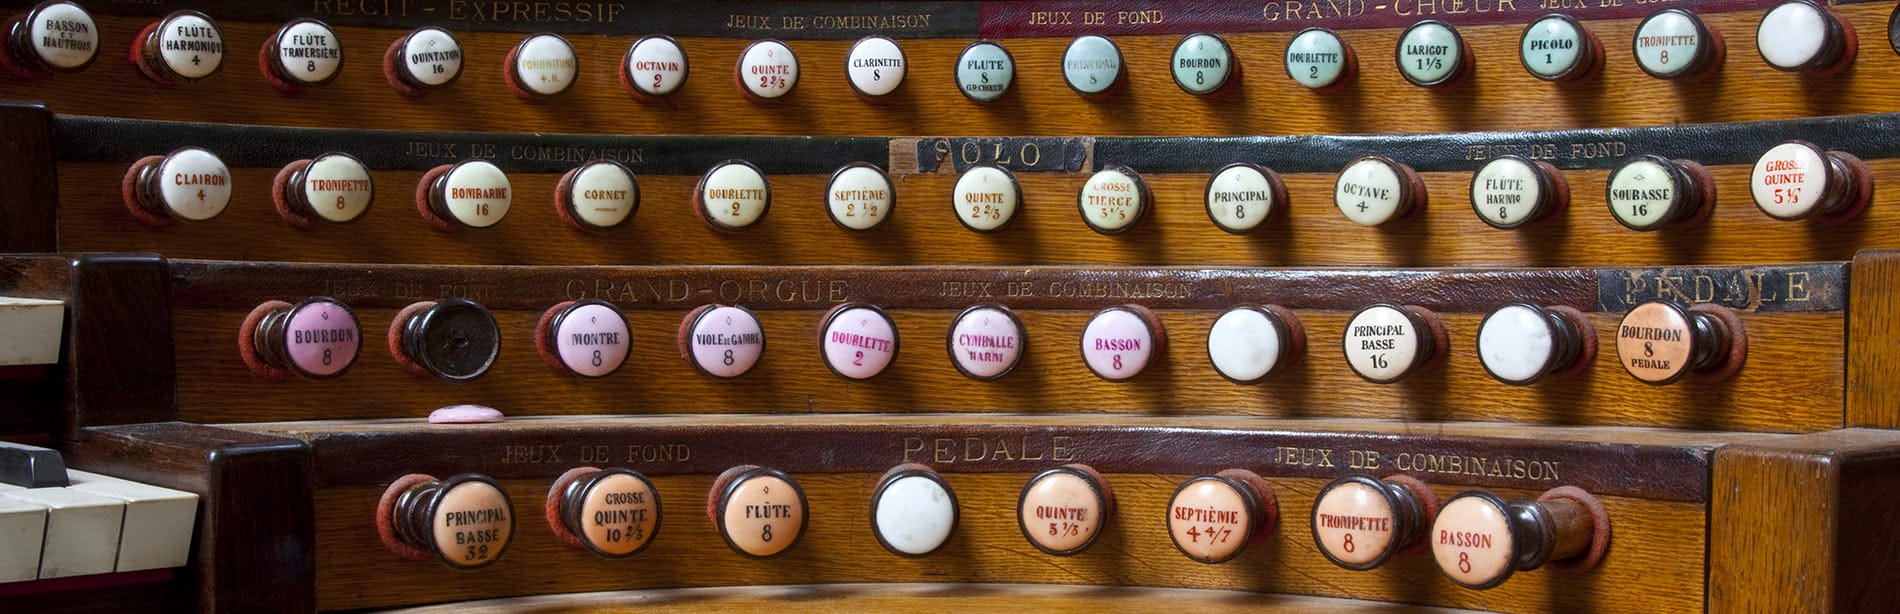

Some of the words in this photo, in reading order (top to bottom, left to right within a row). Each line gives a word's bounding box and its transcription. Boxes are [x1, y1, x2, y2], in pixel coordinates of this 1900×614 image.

[727, 15, 771, 30] JEUX
[783, 16, 804, 29] DE
[813, 14, 930, 29] COMBINAISON
[1029, 12, 1072, 25] JEUX
[1085, 12, 1104, 25] DE
[1118, 11, 1163, 24] FOND
[46, 19, 88, 32] BASSON
[43, 36, 92, 51] HAUTBOIS
[1531, 39, 1573, 50] PICOLO
[1639, 35, 1696, 47] TROMPETTE
[1407, 45, 1448, 56] LARIGOT
[1660, 50, 1669, 64] 8
[192, 54, 200, 65] 4
[411, 51, 460, 64] QUINTATON
[853, 58, 901, 68] CLARINETTE
[1180, 58, 1221, 69] BOURDON
[1290, 53, 1338, 63] DOUBLETTE
[1545, 54, 1552, 64] 1
[307, 60, 316, 72] 8
[432, 64, 444, 74] 16
[636, 61, 678, 72] OCTAVIN
[751, 65, 789, 75] QUINTE
[967, 60, 1004, 70] FLUTE
[1067, 59, 1117, 70] PRINCIPAL
[1417, 59, 1423, 70] 1
[873, 69, 881, 81] 8
[981, 72, 988, 84] 8
[1090, 74, 1097, 84] 8
[1196, 70, 1204, 85] 8
[1310, 66, 1318, 79] 2
[653, 73, 662, 88] 2
[760, 77, 768, 88] 2
[406, 142, 457, 158] JEUX
[471, 144, 496, 159] DE
[511, 145, 643, 163] COMBINAISON
[935, 140, 1040, 166] SOLO
[1530, 144, 1555, 160] DE
[1571, 142, 1626, 159] FOND
[1766, 160, 1806, 172] GROSS
[175, 173, 225, 186] CLAIRON
[311, 179, 369, 192] TROMPETTE
[1764, 173, 1804, 185] QUINTE
[196, 189, 205, 201] 4
[452, 187, 507, 200] BOMBARDE
[584, 190, 627, 200] CORNET
[709, 189, 763, 200] DOUBLETTE
[1214, 190, 1268, 203] PRINCIPAL
[1344, 182, 1389, 200] OCTAVE
[1612, 188, 1670, 201] SOUBASSE
[1774, 189, 1783, 204] 5
[336, 196, 345, 209] 8
[965, 193, 1004, 203] QUINTE
[1088, 195, 1132, 206] TIERCE
[476, 203, 489, 216] 16
[732, 202, 740, 216] 2
[846, 204, 855, 216] 2
[972, 206, 980, 218] 2
[1236, 205, 1245, 219] 8
[1356, 201, 1369, 212] 4
[1499, 206, 1507, 219] 8
[1631, 205, 1648, 217] 16
[939, 282, 992, 298] JEUX
[1007, 282, 1033, 297] DE
[1050, 282, 1194, 299] COMBINAISON
[294, 329, 353, 343] BOURDON
[1353, 324, 1405, 337] PRINCIPAL
[1621, 325, 1682, 342] BOURDON
[572, 332, 620, 345] MONTRE
[832, 331, 891, 352] DOUBLETTE
[959, 333, 1014, 349] CYMBALLE
[1095, 338, 1141, 350] BASSON
[1361, 339, 1395, 350] BASSE
[1644, 342, 1654, 358] 8
[322, 348, 332, 366] 8
[592, 350, 602, 367] 8
[723, 350, 734, 365] 8
[853, 351, 863, 366] 2
[1112, 354, 1122, 370] 8
[1370, 353, 1388, 369] 16
[1631, 358, 1671, 370] PEDALE
[502, 445, 562, 464] JEUX
[580, 446, 609, 463] DE
[626, 444, 690, 463] FOND
[903, 435, 1075, 463] PEDALE
[1275, 447, 1334, 468] JEUX
[1350, 449, 1380, 470] DE
[1397, 452, 1560, 481] COMBINAISON
[605, 492, 645, 505] GROSSE
[446, 508, 506, 527] PRINCIPAL
[594, 508, 648, 526] QUINTE
[1036, 505, 1085, 521] QUINTE
[1175, 506, 1239, 525] SEPTIÈME
[1320, 513, 1390, 532] TROMPETTE
[606, 528, 621, 542] 10
[761, 524, 772, 542] 8
[1049, 523, 1057, 536] 5
[1186, 526, 1200, 543] 4
[456, 529, 499, 545] BASSE
[1343, 533, 1355, 553] 8
[1440, 530, 1492, 549] BASSON
[465, 545, 489, 561] 32
[1458, 552, 1471, 574] 8
